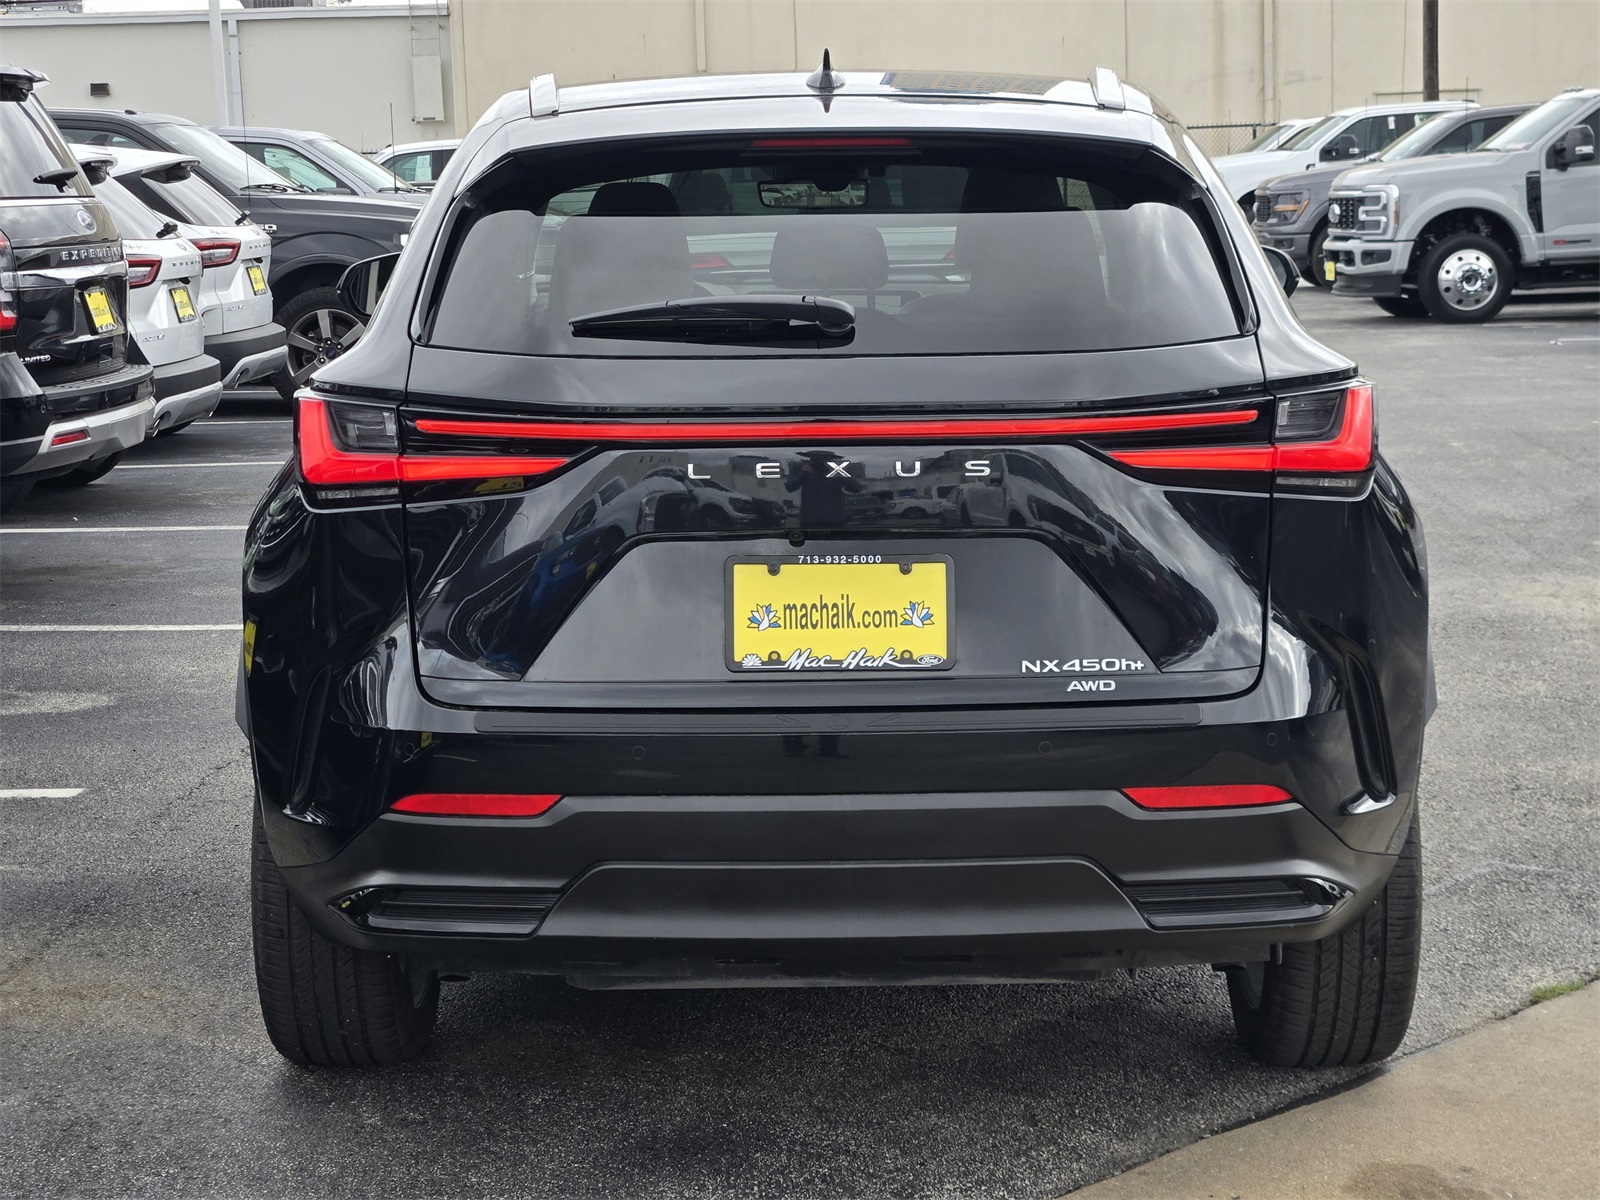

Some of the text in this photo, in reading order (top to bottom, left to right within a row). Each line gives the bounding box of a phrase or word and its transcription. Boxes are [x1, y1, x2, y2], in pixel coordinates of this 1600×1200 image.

[687, 460, 991, 479] LEXUS
[797, 555, 882, 564] 713-932-5000
[783, 594, 898, 630] machaik.com
[784, 647, 898, 670] Mac Haik
[1066, 680, 1116, 692] AWD
